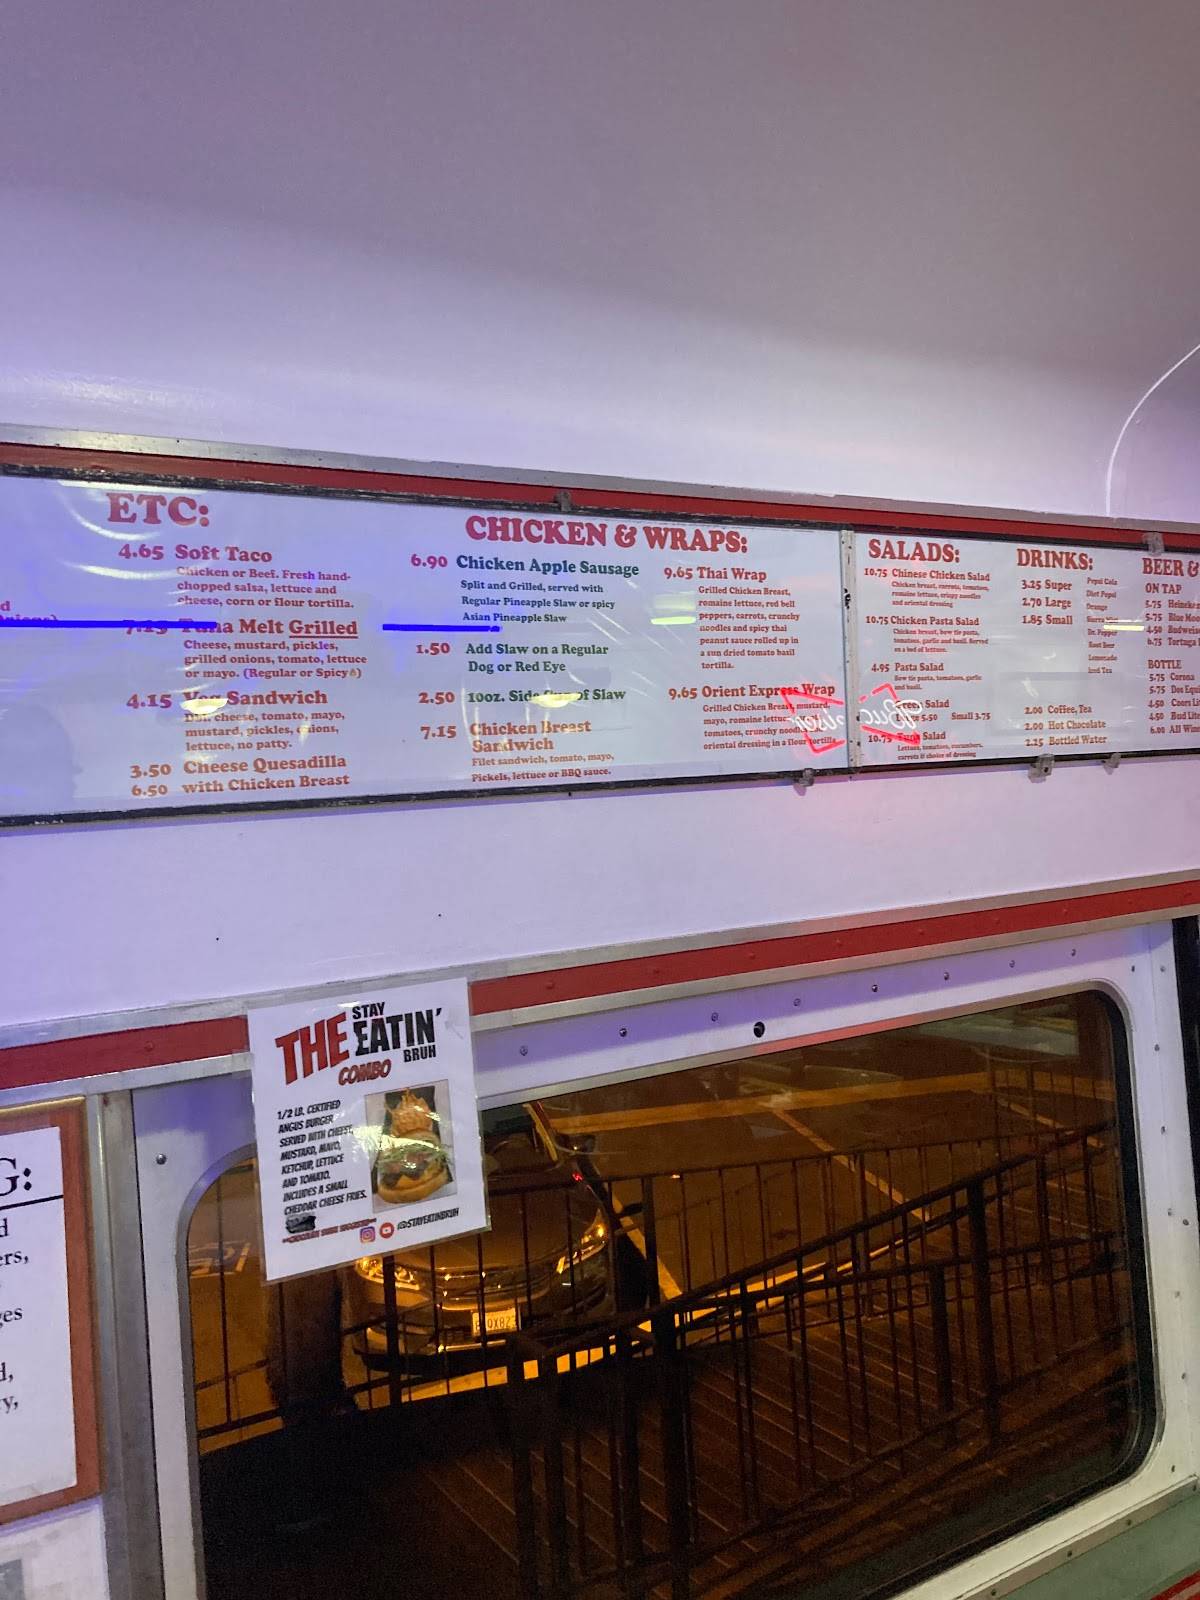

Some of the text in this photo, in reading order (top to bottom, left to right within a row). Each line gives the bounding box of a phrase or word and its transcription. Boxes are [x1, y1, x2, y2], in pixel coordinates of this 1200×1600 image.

[106, 493, 210, 527] ETC:
[466, 514, 748, 554] CHICKEN & WRAPS:
[118, 543, 273, 563] 4.65 Soft Taco
[868, 538, 960, 564] SALADS:
[1017, 548, 1094, 570] DRINKS:
[410, 553, 639, 579] 6.90 Chicken Apple Sausage
[664, 566, 767, 583] 9.65 Thai Wrap
[1187, 560, 1200, 578] &
[177, 580, 232, 593] chopped
[270, 583, 313, 594] lettuce
[315, 586, 337, 595] and
[460, 579, 485, 591] Split
[487, 581, 507, 590] and
[548, 584, 579, 592] served
[581, 584, 604, 593] with
[698, 585, 728, 594] Grilled
[729, 586, 762, 595] Chicken
[1045, 579, 1072, 592] Super
[225, 598, 255, 606] corn
[257, 599, 272, 607] or
[274, 597, 305, 607] flour
[698, 599, 733, 607] romaine
[766, 600, 779, 608] red
[780, 600, 796, 608] bell
[1045, 597, 1072, 610] Large
[239, 618, 284, 634] Melt
[288, 620, 358, 635] Grilled
[463, 612, 567, 624] Asian Pineapple Slaw
[416, 642, 609, 657] 1.50 Add Slaw on a Regular
[184, 654, 227, 666] grilled
[327, 654, 367, 664] lettuce
[468, 661, 566, 675] Dog or Red Eye
[126, 694, 172, 709] 4.15
[226, 690, 328, 706] Sandwich
[418, 692, 455, 705] 2.50
[592, 688, 626, 701] Slaw
[668, 683, 835, 700] 9.65 Orient Wrap
[420, 720, 592, 740] 7.15 Chicken Breast
[472, 738, 554, 753] Sandwich
[130, 754, 347, 779] 3.50 Cheese Quesadilla
[512, 772, 546, 780] lettuce
[561, 768, 582, 778] BBQ
[131, 774, 350, 796] 6.50 with Chicken Breast
[353, 1002, 385, 1020] STAY
[274, 1008, 442, 1086] THE EATIN'
[404, 1045, 436, 1062] BRUH
[338, 1059, 392, 1086] COMBO
[278, 1110, 292, 1120] 1/2
[306, 1100, 340, 1114] CERTIFIED
[278, 1114, 334, 1134] ANGUS BURGER
[280, 1130, 326, 1147] SERVED WITH
[316, 1154, 344, 1168] LETTUCE
[282, 1177, 298, 1188] AND
[283, 1180, 348, 1202] INCLUDES A SMALL
[284, 1200, 318, 1215] CHEDDAR
[319, 1194, 344, 1208] CHEESE
